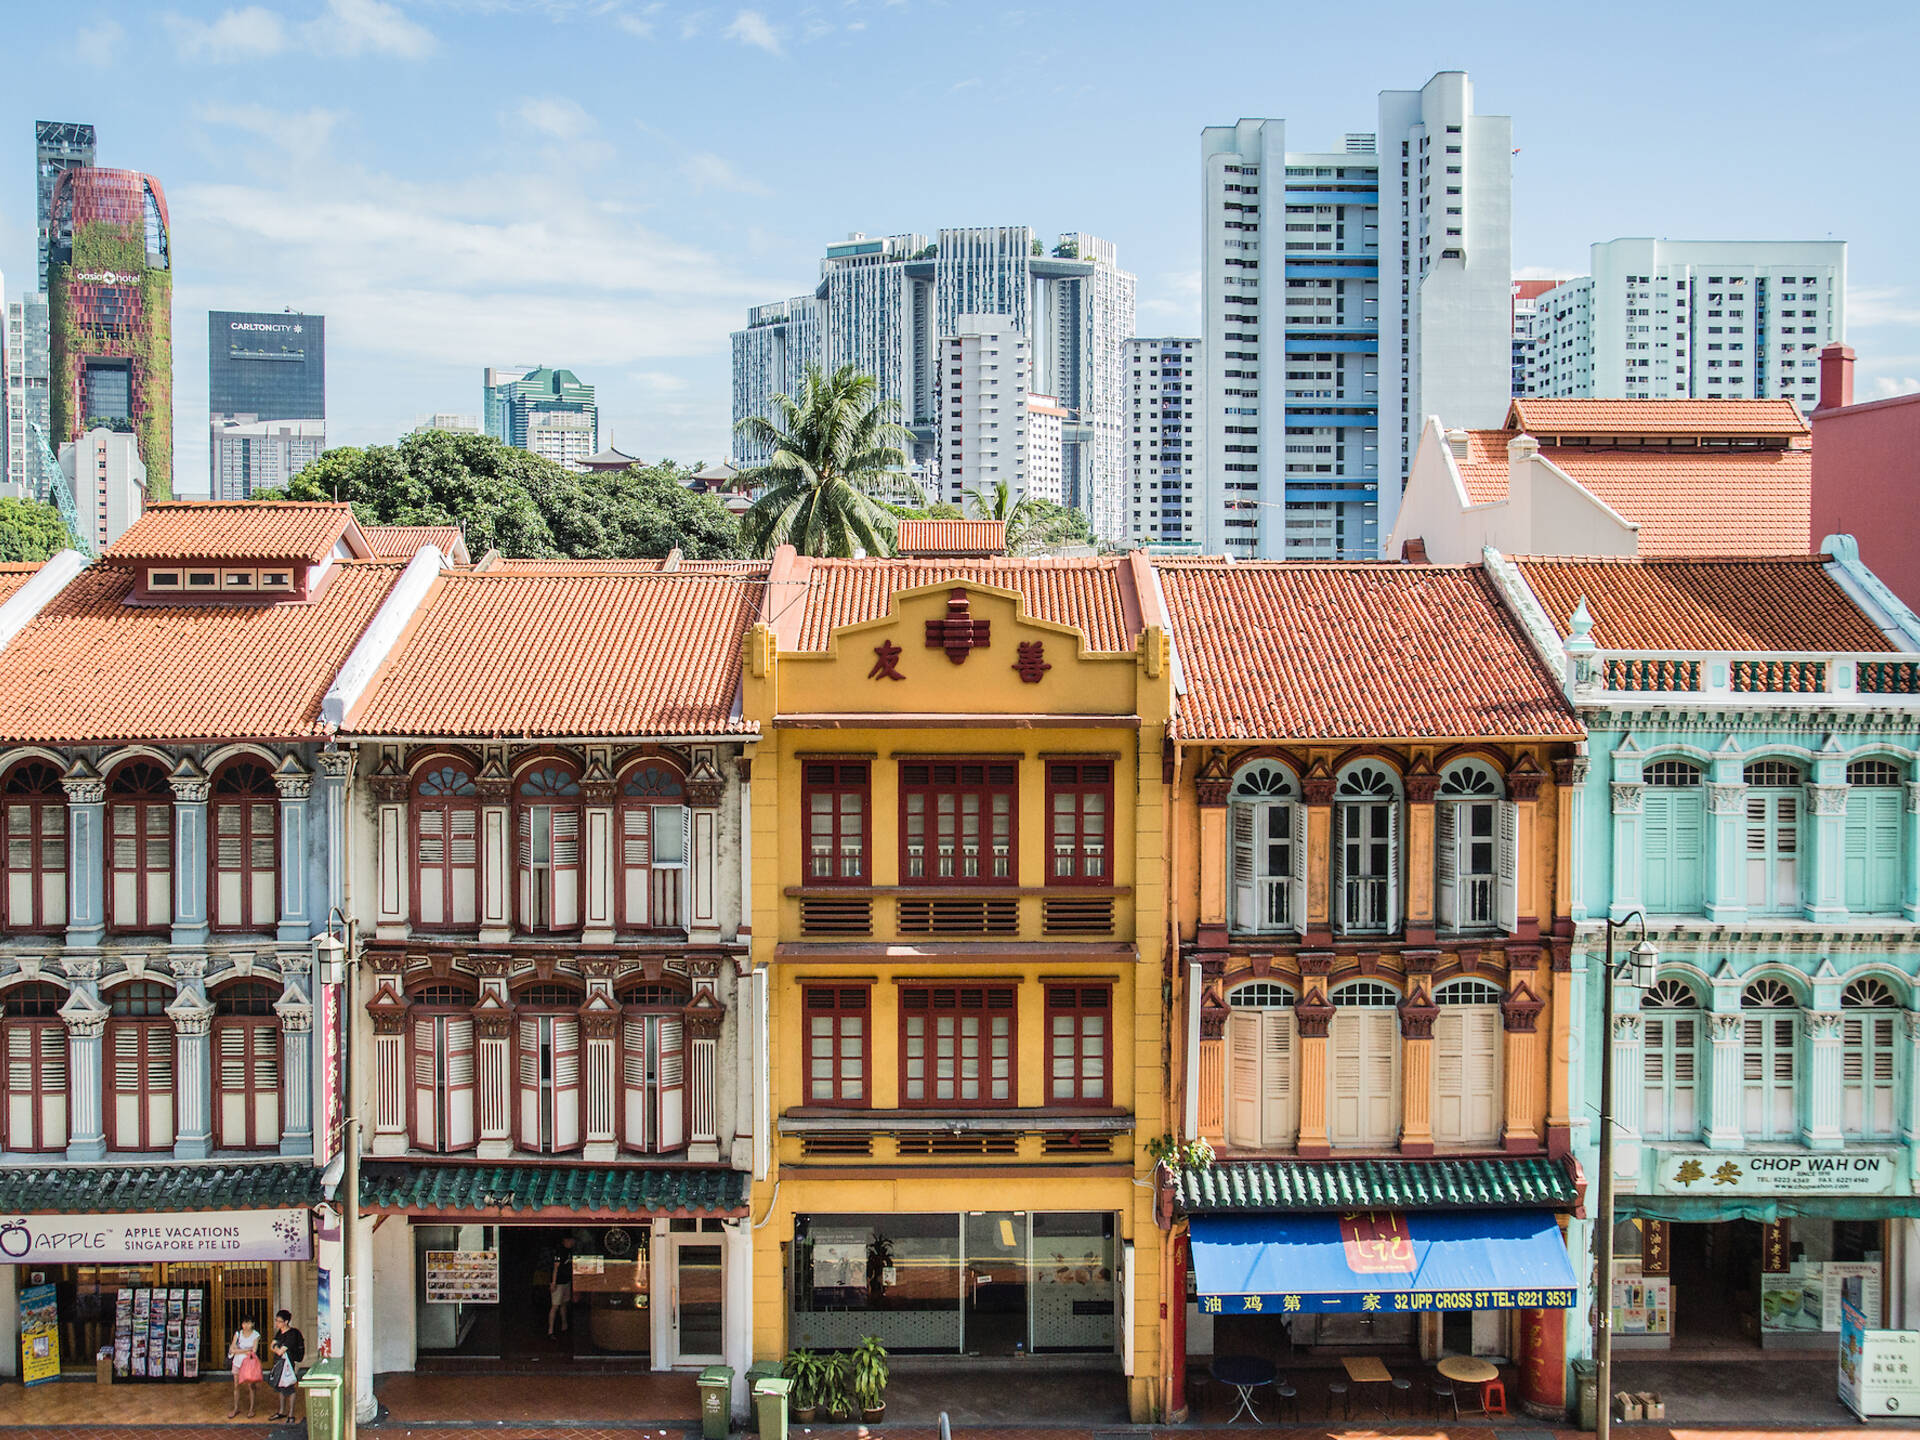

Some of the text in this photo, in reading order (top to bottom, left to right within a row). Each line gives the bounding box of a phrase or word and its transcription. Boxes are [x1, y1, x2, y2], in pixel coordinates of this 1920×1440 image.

[77, 272, 140, 282] oasia hotel
[868, 639, 1052, 683] 友 善
[1751, 1158, 1880, 1171] CHOP WAH ON
[125, 1227, 240, 1238] APPLE VACATIONS
[34, 1232, 106, 1249] APPLE
[124, 1240, 240, 1250] SINGAPORE PTE LTD
[1204, 1293, 1382, 1313] 油鸡第一家
[1394, 1291, 1572, 1310] 32 UPP CROSS ST TEL: 6221 3531
